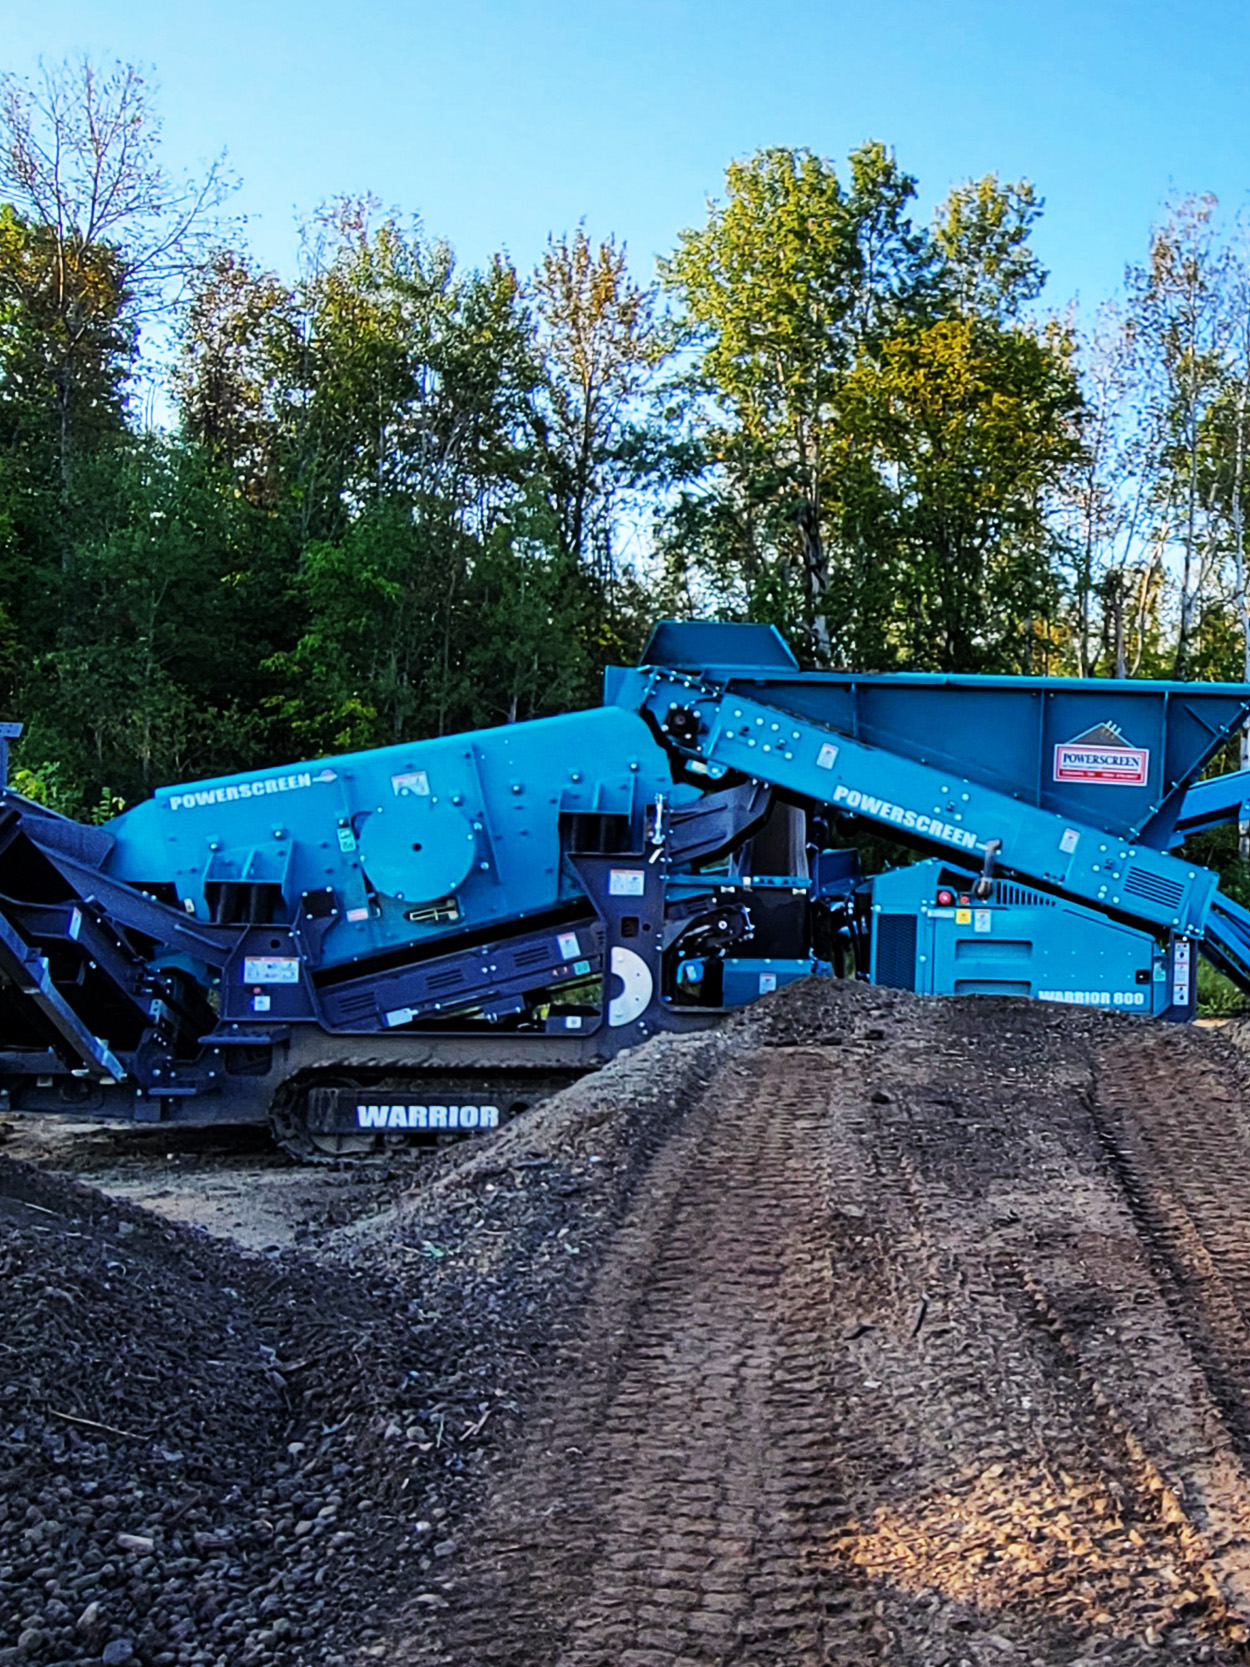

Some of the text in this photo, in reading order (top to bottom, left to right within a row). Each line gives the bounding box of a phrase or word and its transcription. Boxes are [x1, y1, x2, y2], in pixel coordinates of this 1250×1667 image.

[1063, 753, 1139, 767] POWERSCREEN
[169, 772, 312, 811] POWERSCREEN
[832, 784, 978, 849] POWERSCREEN
[1038, 990, 1145, 1005] WARRIOR 800
[357, 1105, 500, 1128] WARRIOR
